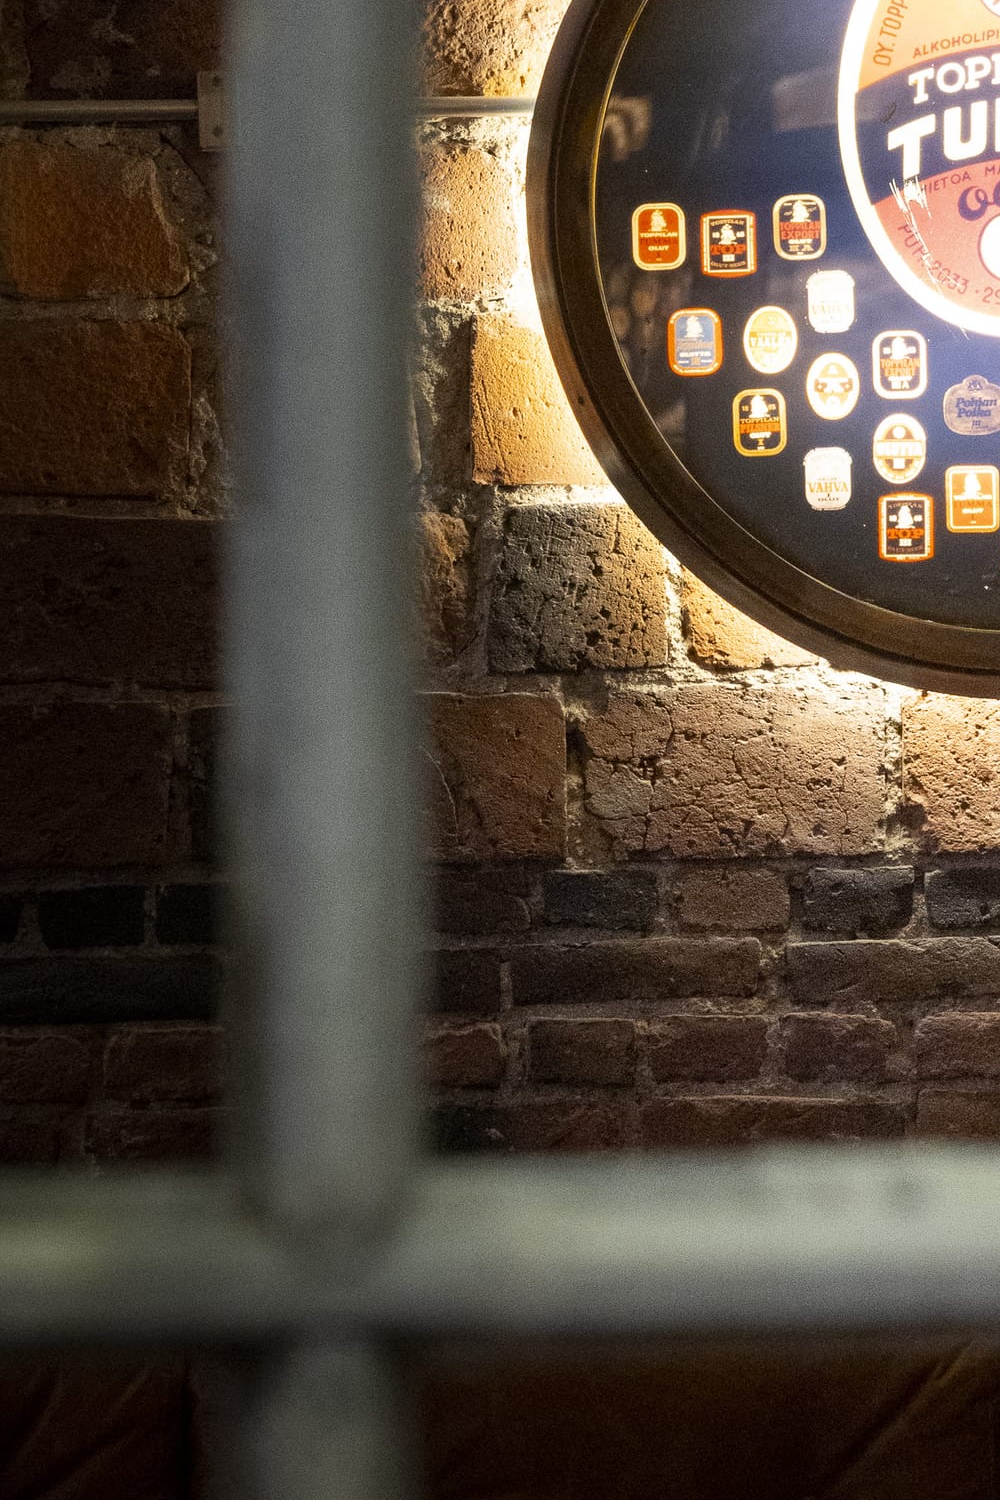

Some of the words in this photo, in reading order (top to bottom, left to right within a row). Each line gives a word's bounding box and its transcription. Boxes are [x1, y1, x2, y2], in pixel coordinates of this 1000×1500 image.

[780, 222, 821, 231] TOPPILAN
[781, 231, 820, 240] EXPORT
[710, 243, 747, 255] TOP
[740, 423, 781, 435] PILSNER
[808, 482, 849, 493] VAHVA
[887, 528, 925, 539] TOP
